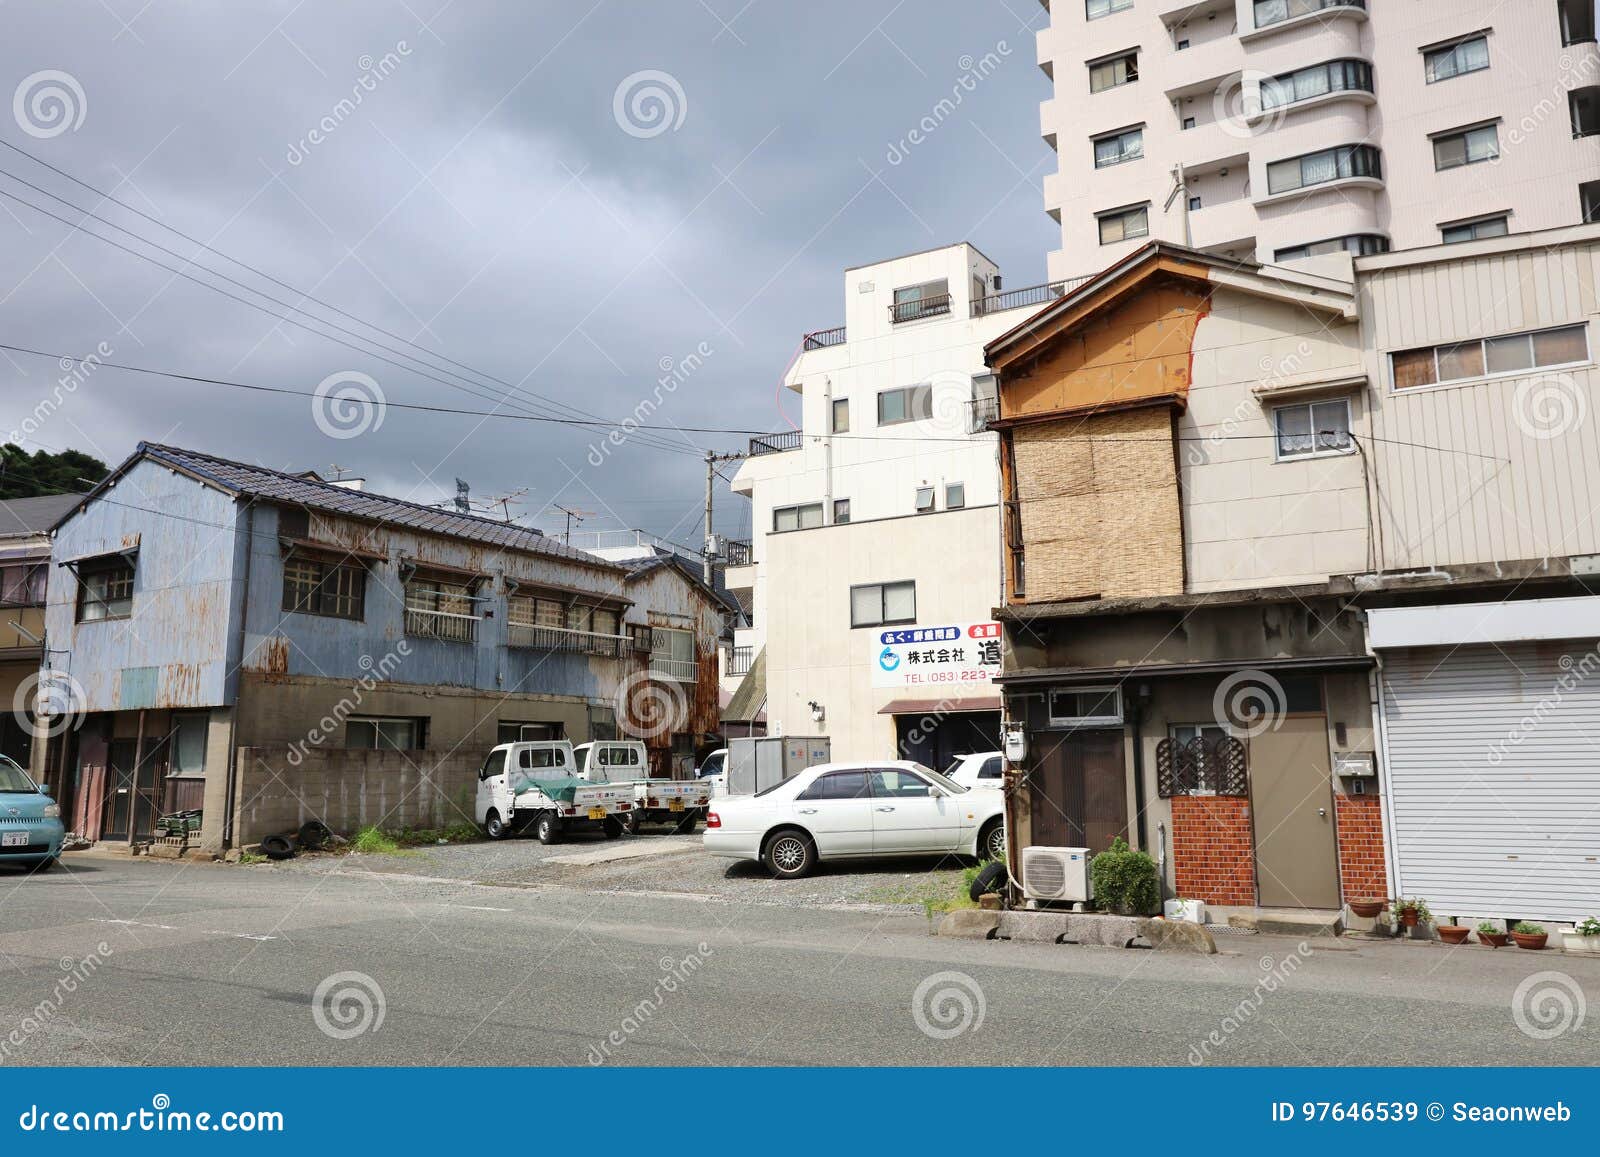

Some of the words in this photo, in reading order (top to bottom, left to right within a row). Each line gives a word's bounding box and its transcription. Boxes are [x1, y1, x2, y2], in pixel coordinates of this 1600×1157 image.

[908, 648, 965, 664] 株式会社
[904, 673, 925, 684] TEL
